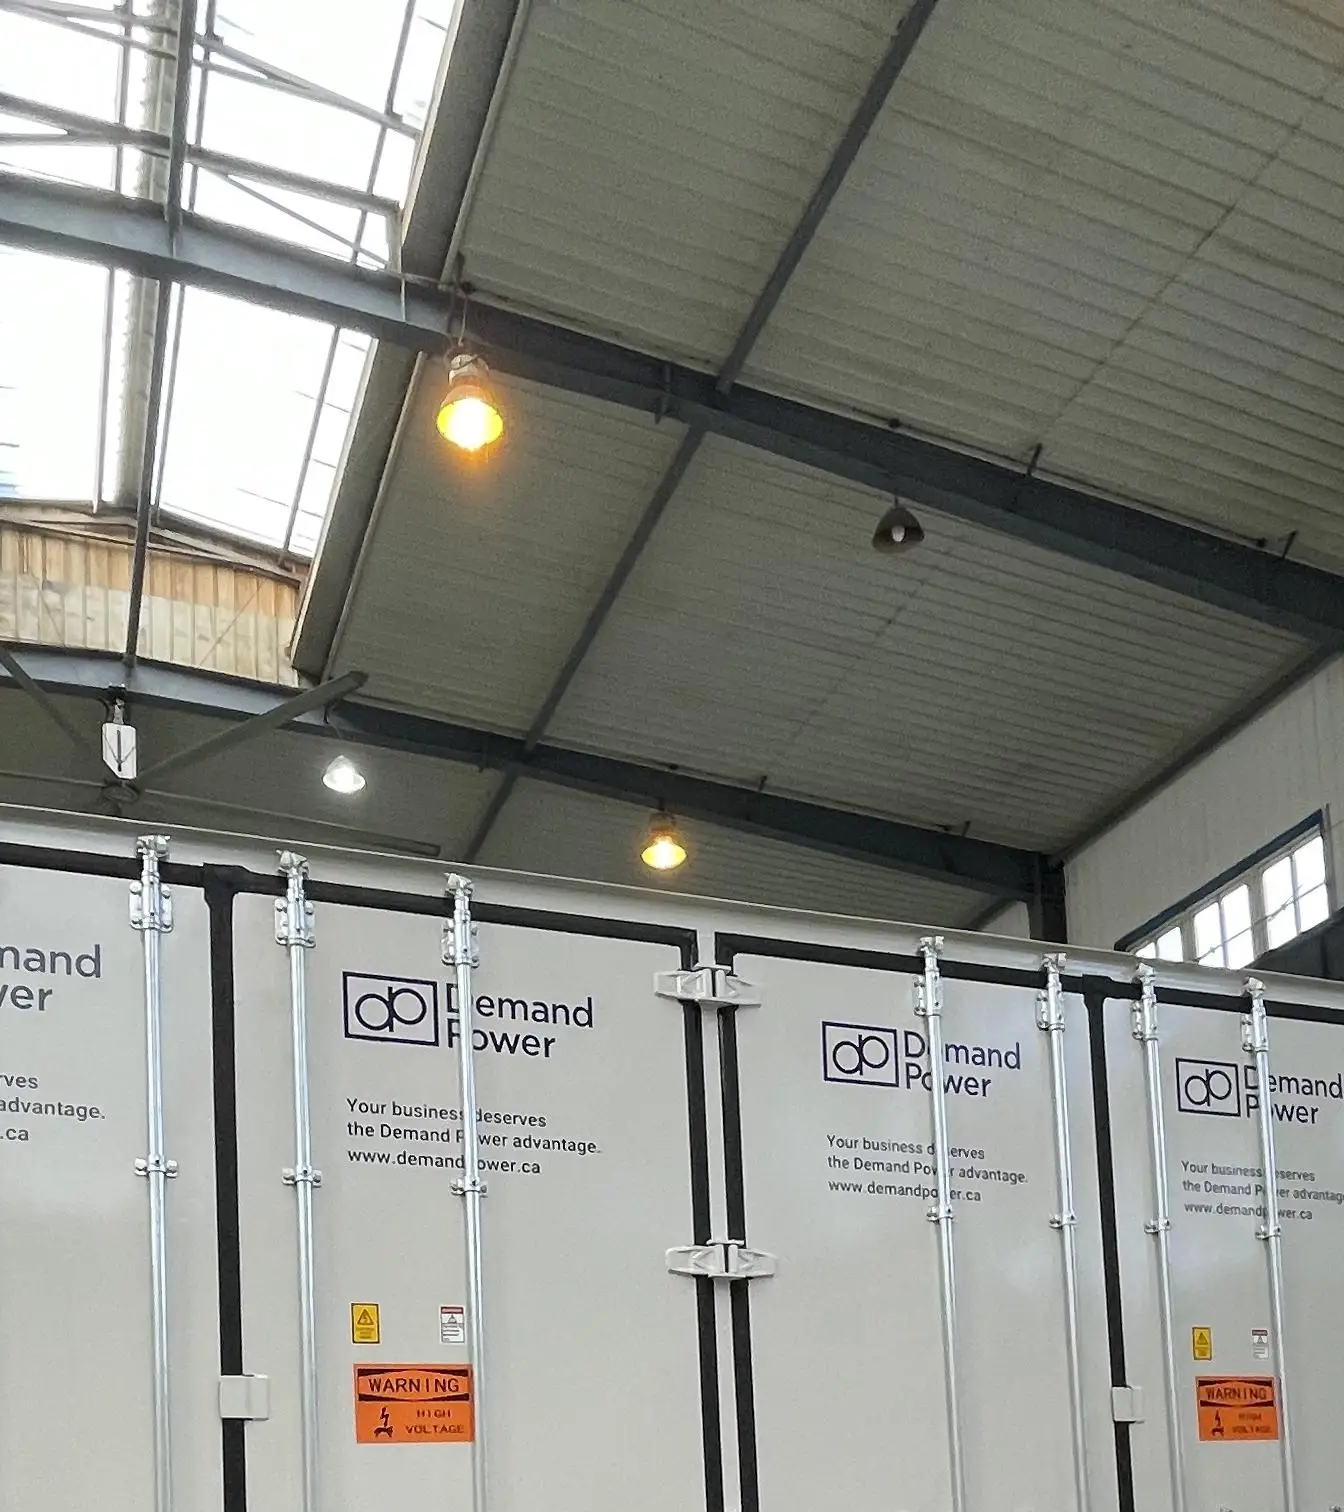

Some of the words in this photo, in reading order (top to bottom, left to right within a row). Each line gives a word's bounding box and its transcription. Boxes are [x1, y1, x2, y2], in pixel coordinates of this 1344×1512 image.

[904, 1030, 1021, 1070] Dmand
[347, 1098, 387, 1115] Your
[392, 1101, 464, 1121] business
[475, 1105, 547, 1127] deserves
[1246, 1094, 1319, 1124] Pwer
[347, 1121, 375, 1137] the
[380, 1123, 450, 1143] Demand
[457, 1129, 508, 1147] Pwer
[513, 1134, 602, 1156] advantage.
[826, 1134, 858, 1150] Your
[862, 1137, 923, 1155] business
[927, 1141, 985, 1160] derves
[348, 1150, 541, 1174] www.demandower.ca
[827, 1155, 850, 1169] the
[854, 1157, 909, 1174] Demand
[914, 1161, 955, 1177] Por
[959, 1166, 1029, 1186] advantage.
[1181, 1160, 1208, 1174] Your
[1211, 1163, 1262, 1178] business
[1264, 1168, 1315, 1182] eserves
[828, 1179, 981, 1202] www.demandpoer.ca
[1182, 1179, 1201, 1193] the
[1204, 1180, 1252, 1195] Demand
[1255, 1184, 1290, 1198] Per
[1184, 1201, 1313, 1220] www.demandpwer.ca
[368, 1377, 460, 1393] WARNING
[1205, 1387, 1267, 1400] WARNING
[416, 1408, 451, 1419] HIGH
[405, 1424, 465, 1434] VOLTAGE
